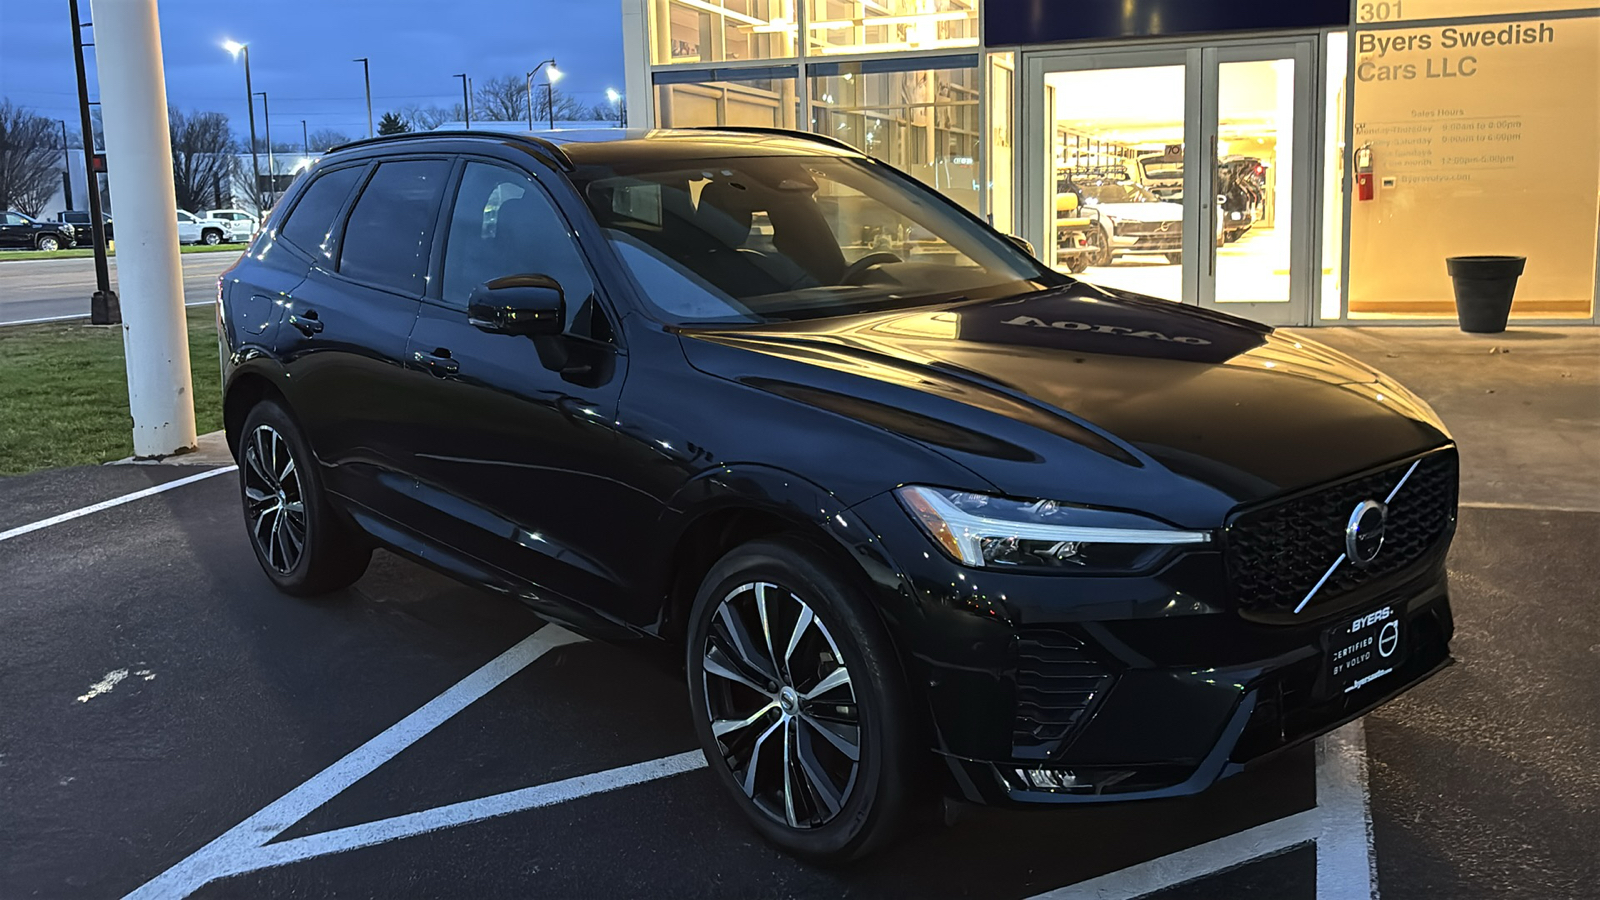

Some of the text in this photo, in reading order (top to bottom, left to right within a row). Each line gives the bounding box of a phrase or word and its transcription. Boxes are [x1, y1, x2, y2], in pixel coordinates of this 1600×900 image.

[1360, 1, 1402, 22] 301
[1359, 22, 1554, 58] Byers Swedish
[1357, 56, 1477, 82] Cars LLC
[1437, 108, 1464, 117] Hours
[1352, 606, 1391, 633] BYERS
[1333, 651, 1371, 675] BY VOLVO
